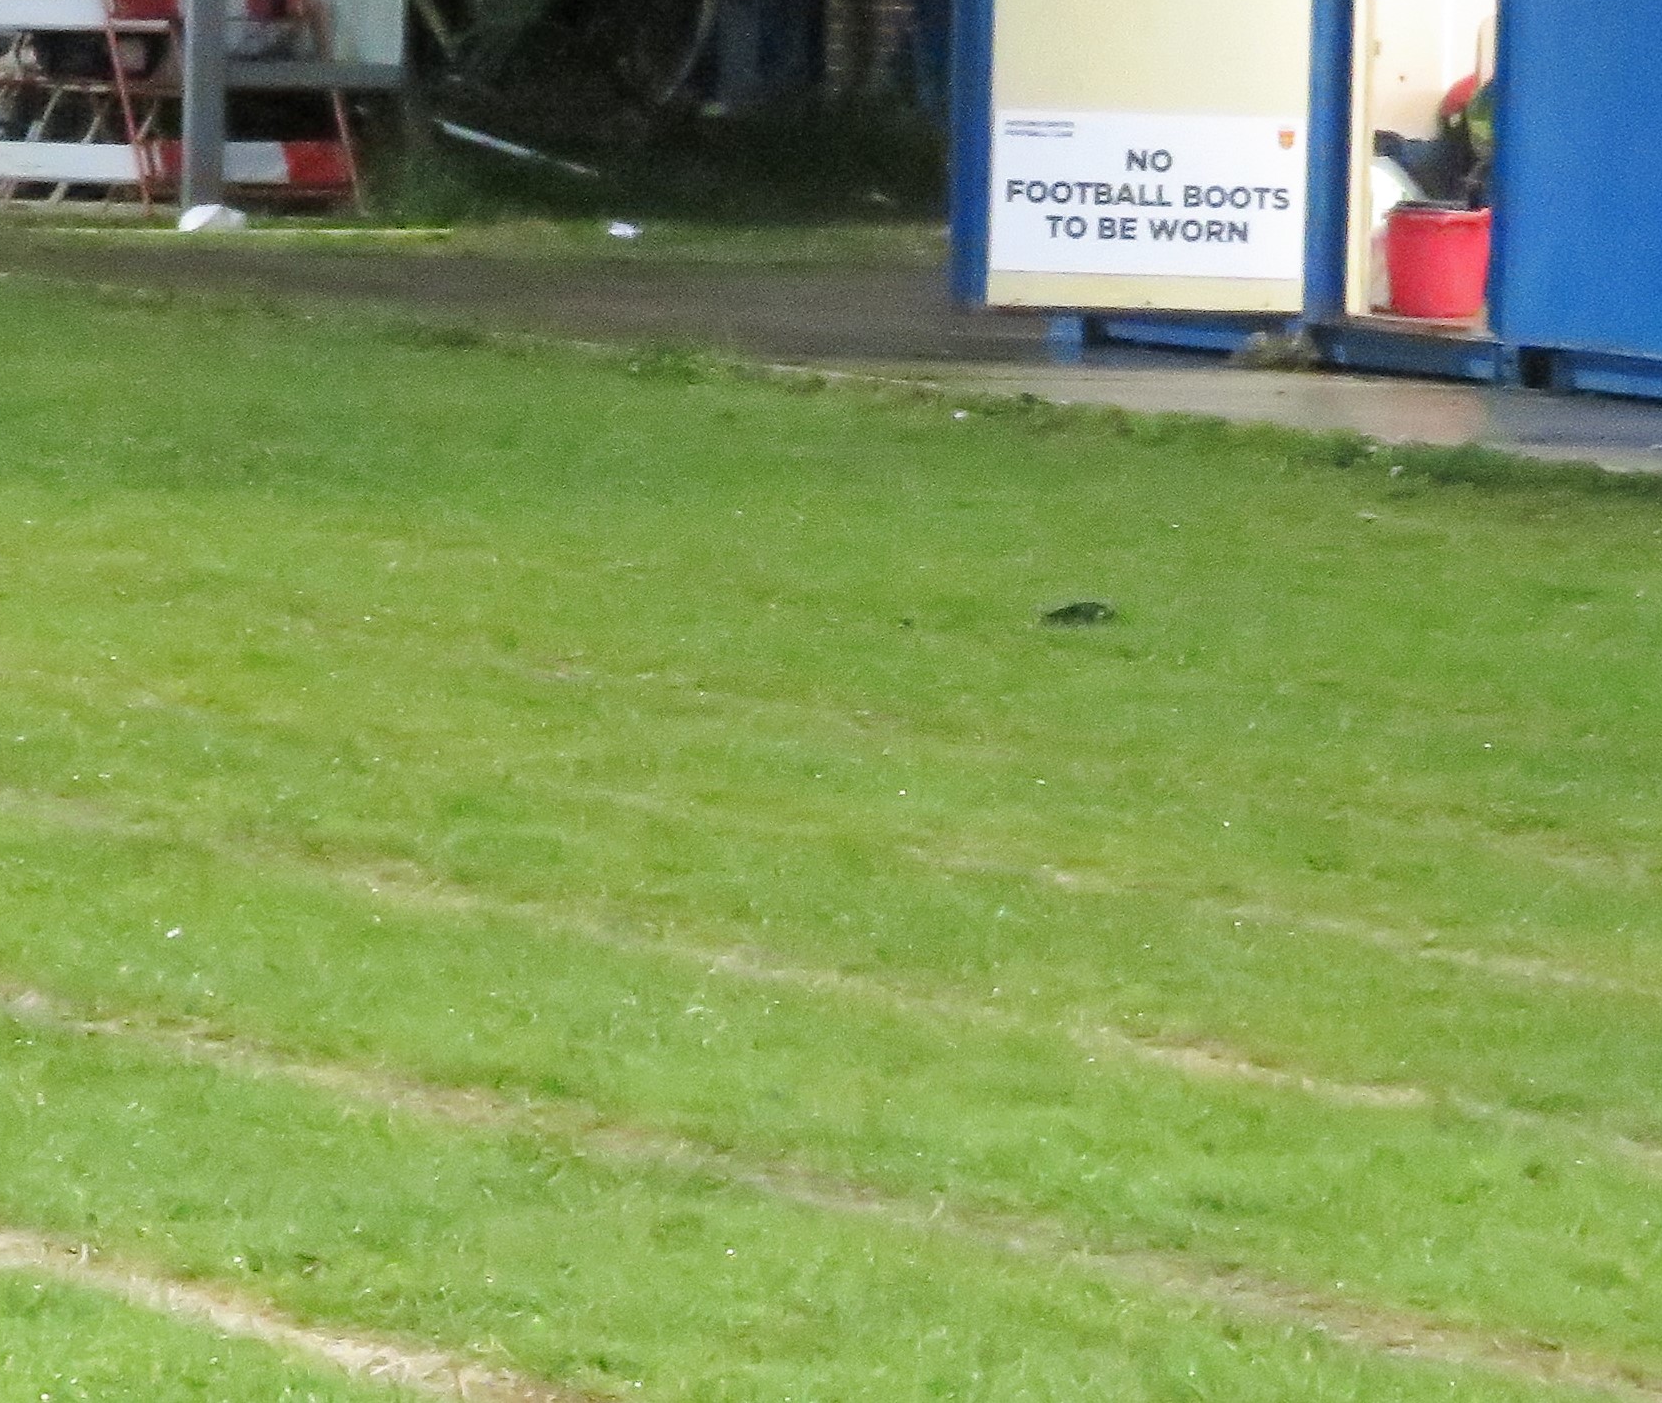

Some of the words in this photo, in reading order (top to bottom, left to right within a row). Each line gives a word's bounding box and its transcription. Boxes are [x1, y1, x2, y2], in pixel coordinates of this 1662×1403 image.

[1125, 149, 1173, 173] NO
[1005, 179, 1173, 208] FOOTBALL
[1183, 184, 1290, 211] BOOTS
[1045, 214, 1088, 240] TO
[1097, 217, 1138, 241] BE
[1148, 218, 1249, 243] WORN
